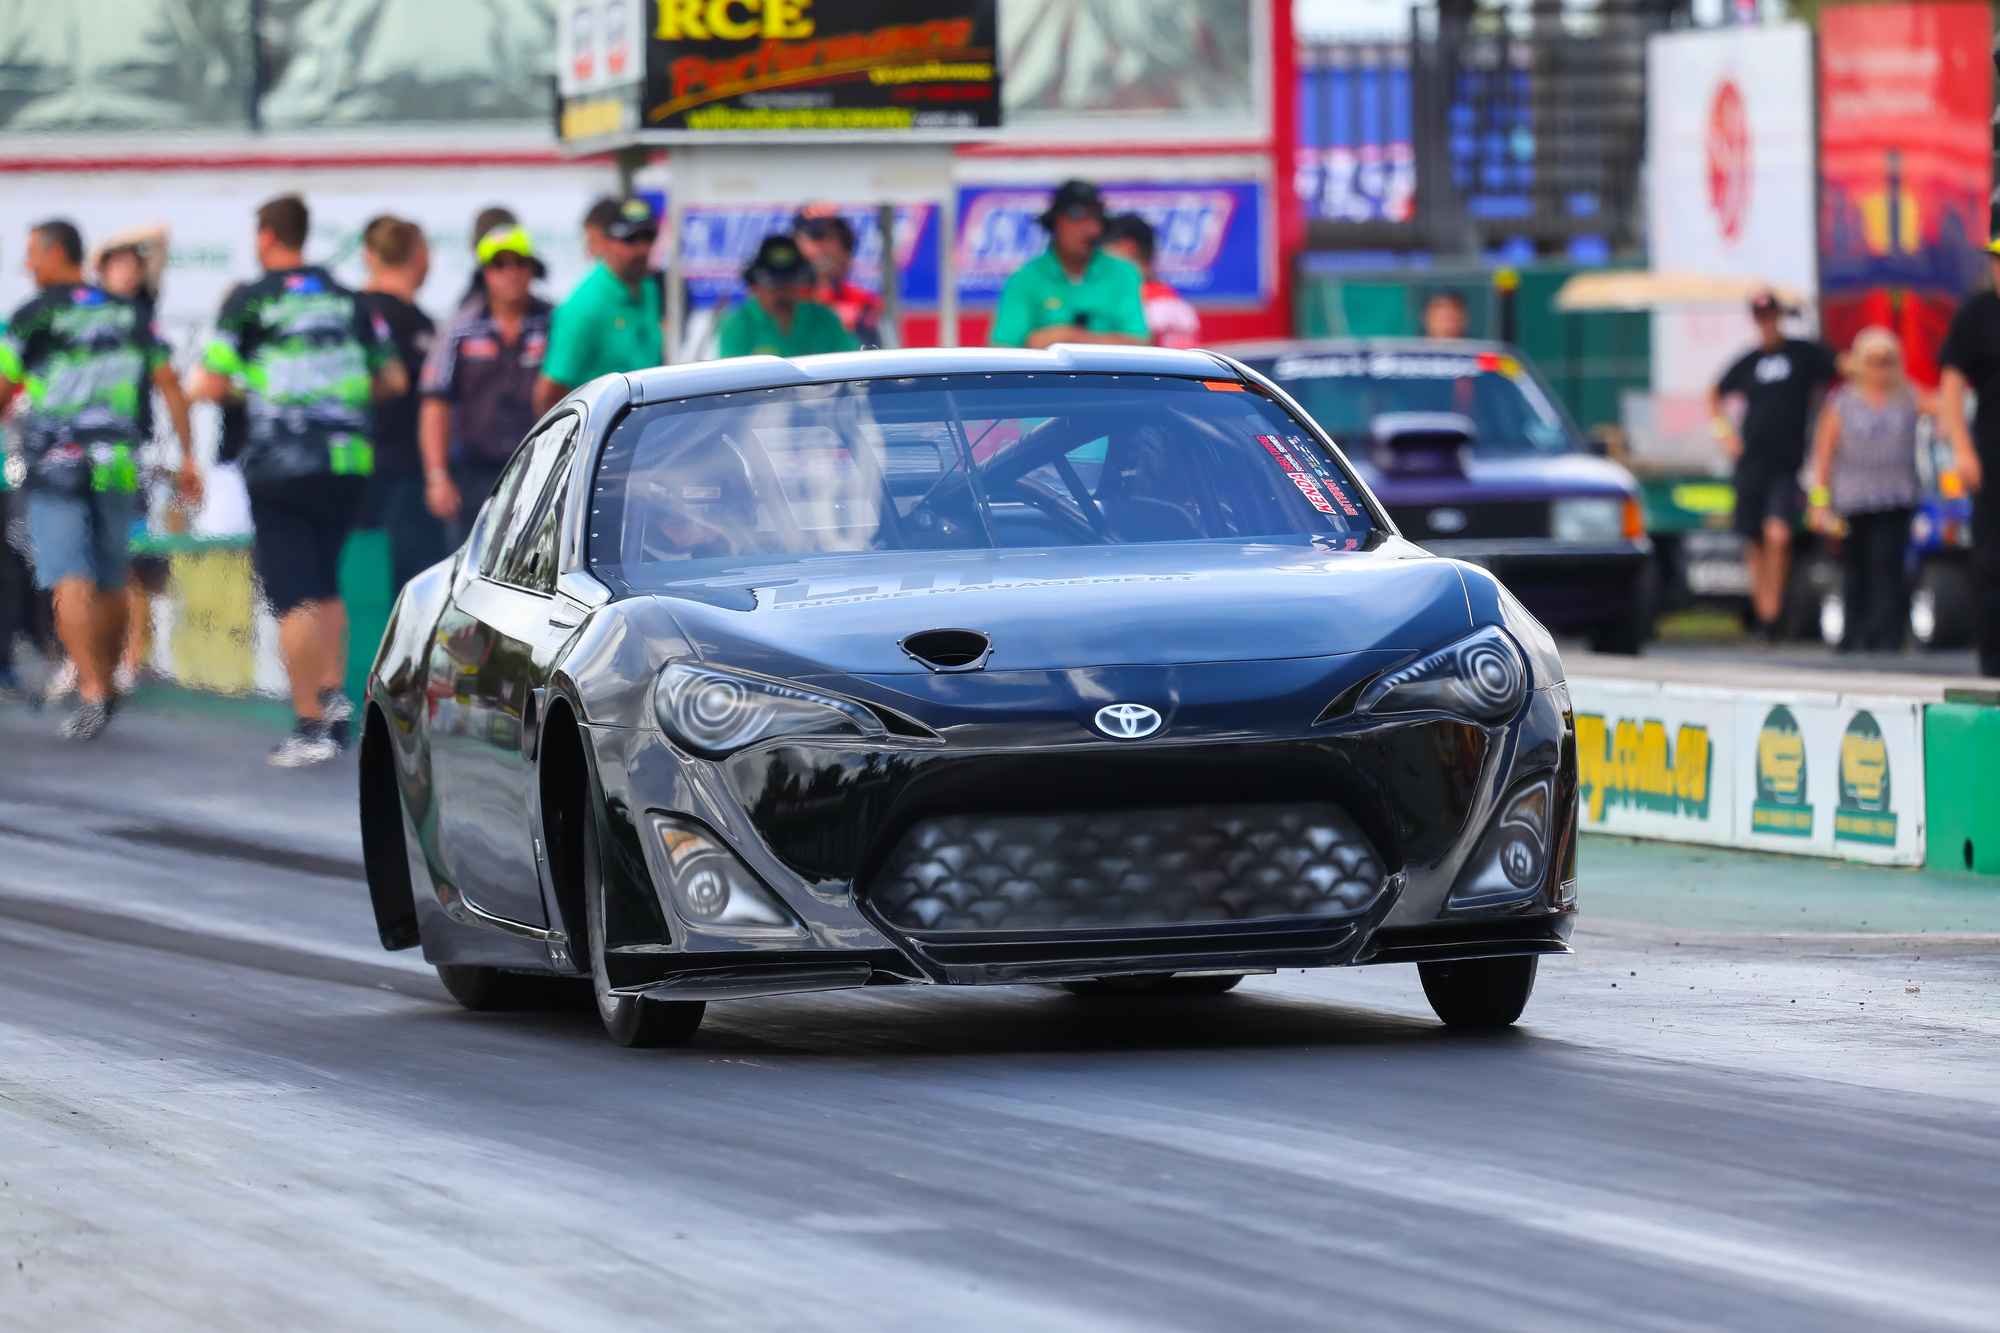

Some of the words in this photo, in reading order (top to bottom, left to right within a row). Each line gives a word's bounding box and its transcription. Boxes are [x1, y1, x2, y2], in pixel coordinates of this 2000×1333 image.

[654, 0, 816, 40] RCE
[1287, 473, 1337, 514] KENDA
[1320, 478, 1359, 516] ENTRANT
[773, 592, 914, 610] ENGINE
[928, 575, 1198, 595] MANAGEMENT
